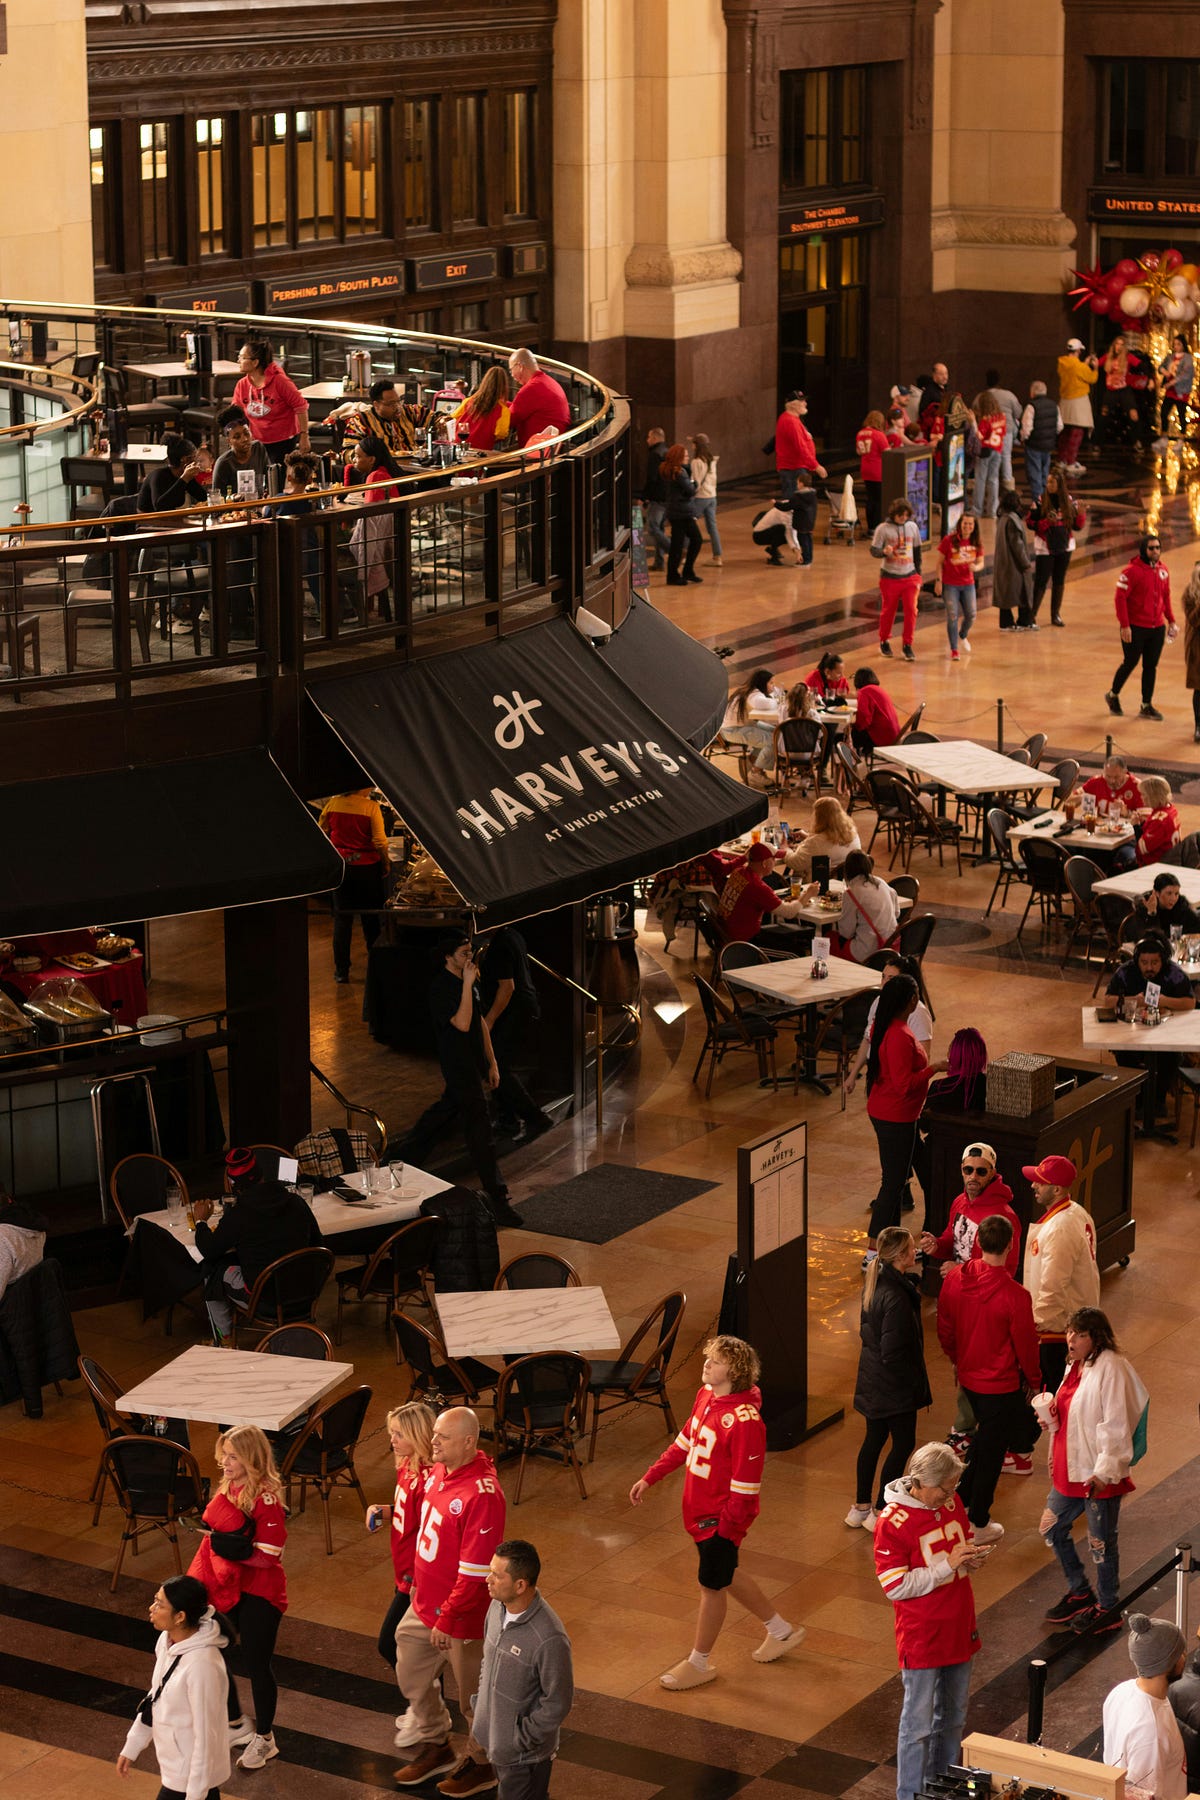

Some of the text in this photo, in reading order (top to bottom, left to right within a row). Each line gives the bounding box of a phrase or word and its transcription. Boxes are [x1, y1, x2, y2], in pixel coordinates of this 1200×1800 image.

[1106, 199, 1154, 211] UNITED
[804, 210, 817, 219] THE
[446, 265, 467, 277] EXIT
[273, 287, 318, 302] PERSHING
[371, 276, 398, 288] PLAZA
[192, 300, 218, 312] EXIT
[456, 741, 681, 846] HARVEY'S
[545, 789, 664, 842] AT UNION STATION
[734, 1403, 760, 1422] 52
[475, 1478, 496, 1494] 15
